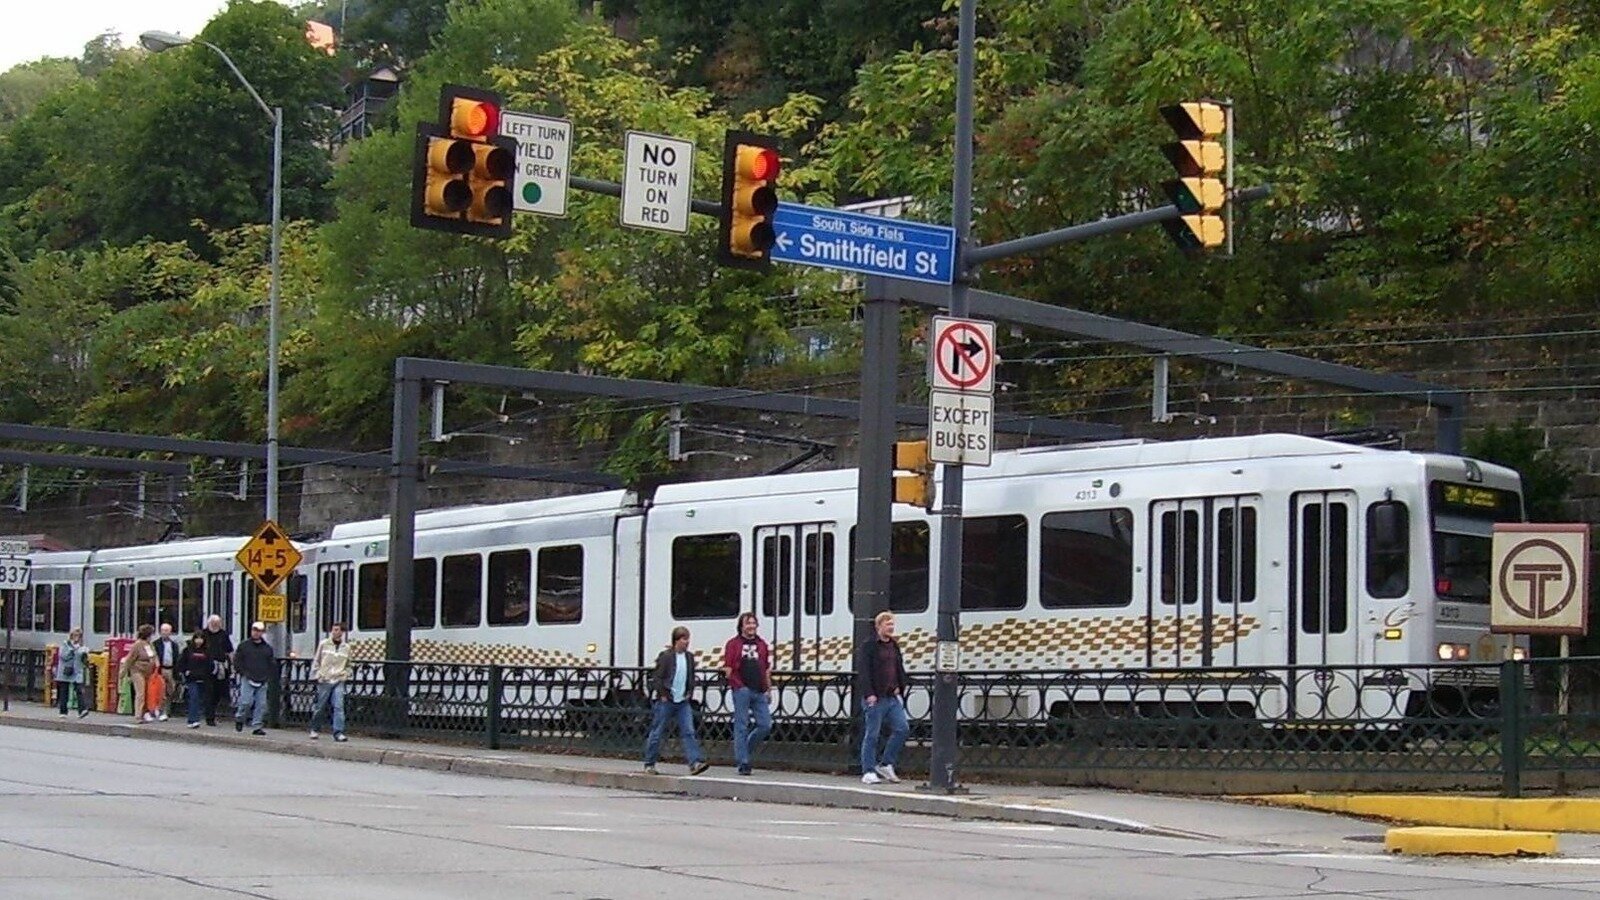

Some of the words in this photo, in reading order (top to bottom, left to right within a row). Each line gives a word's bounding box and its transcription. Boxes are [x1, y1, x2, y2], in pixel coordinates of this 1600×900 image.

[506, 122, 532, 137] LEFT
[538, 126, 565, 141] TURN
[516, 142, 553, 160] YIELD
[643, 143, 676, 167] NO
[526, 163, 561, 179] GREEN
[639, 168, 677, 186] TURN
[646, 189, 667, 204] ON
[641, 206, 669, 224] RED
[813, 215, 846, 232] South
[850, 222, 874, 237] Side
[877, 228, 904, 241] Flats
[800, 233, 906, 271] Smithfield
[915, 251, 938, 275] St
[933, 406, 989, 426] EXCEPT
[935, 431, 986, 450] BUSES
[0, 565, 28, 583] 837
